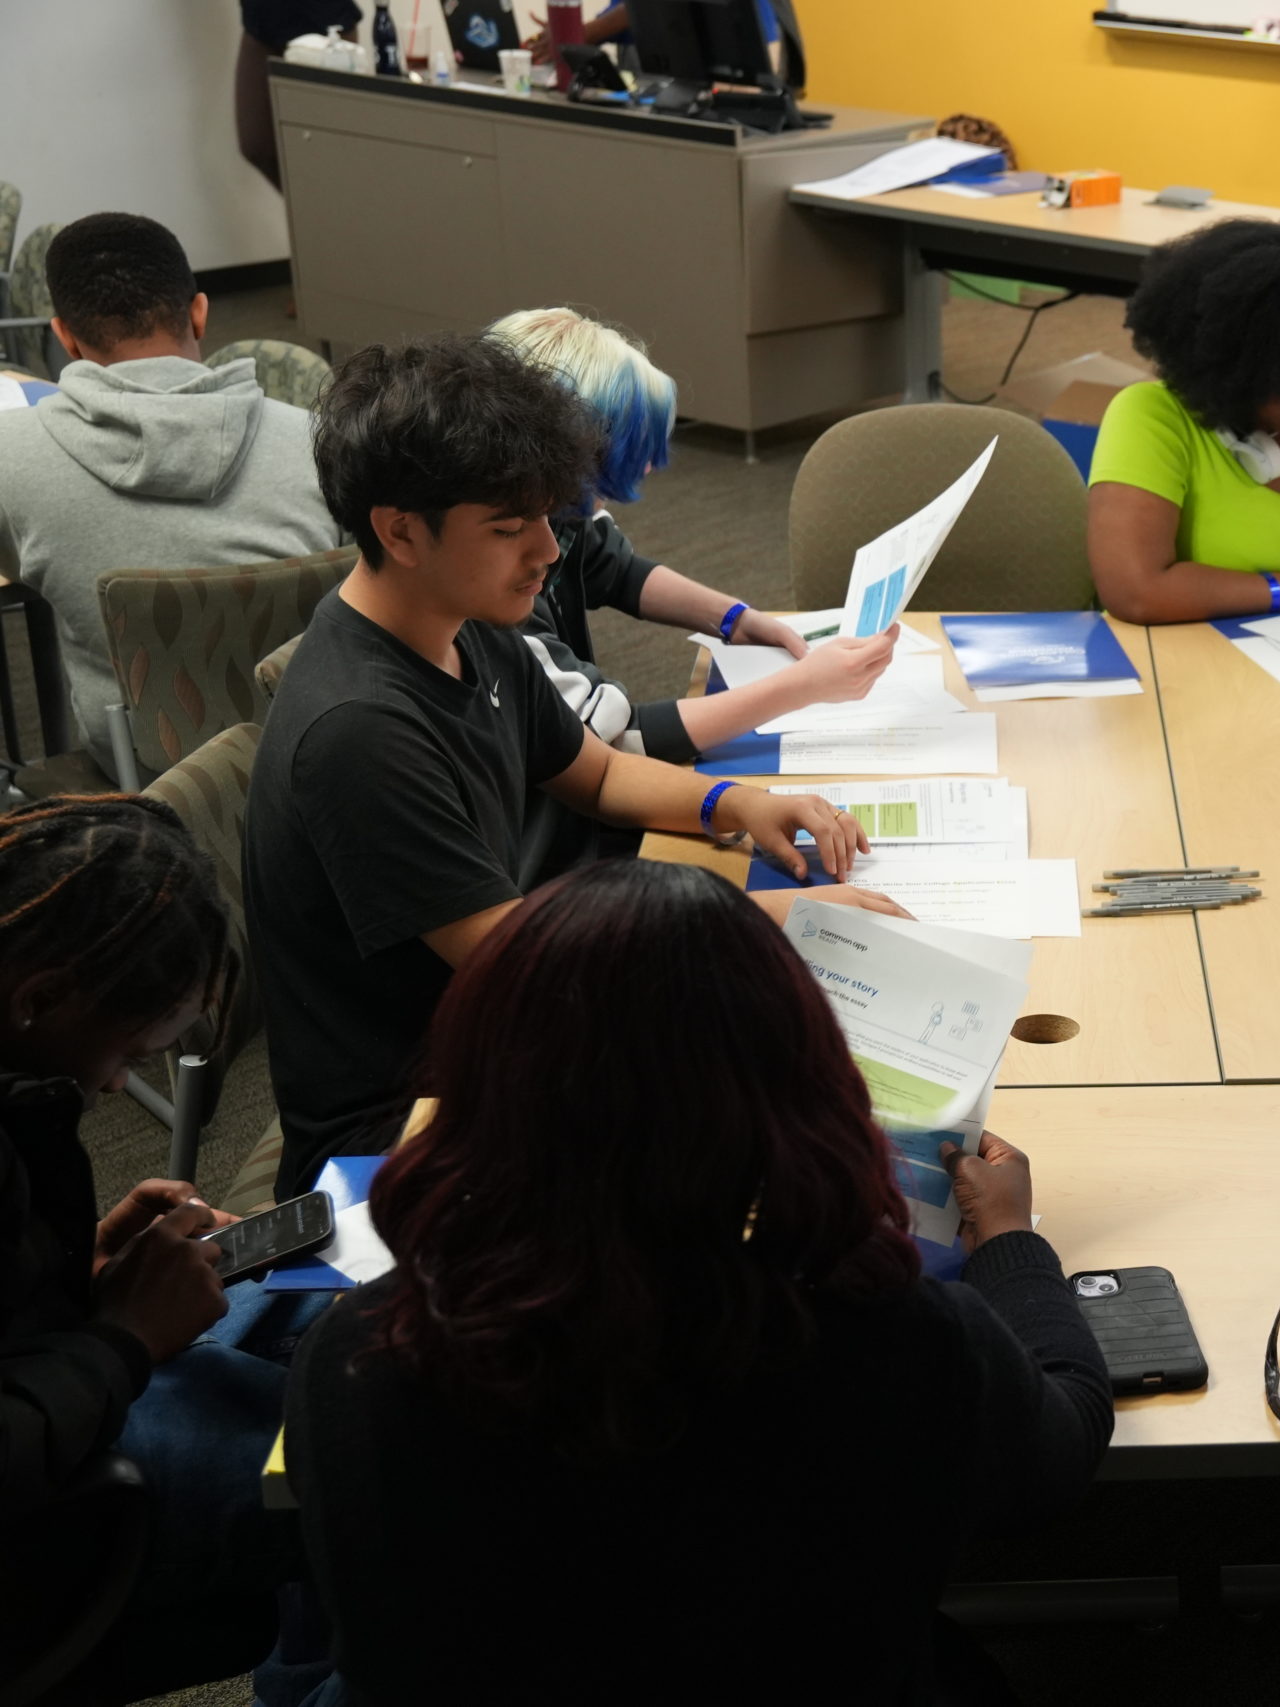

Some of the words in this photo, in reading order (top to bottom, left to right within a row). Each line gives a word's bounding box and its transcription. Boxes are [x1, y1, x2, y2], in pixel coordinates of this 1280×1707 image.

[819, 928, 853, 945] common
[853, 942, 869, 953] app
[826, 970, 850, 985] your
[851, 980, 879, 997] story
[838, 991, 850, 1001] the
[850, 998, 869, 1009] essay
